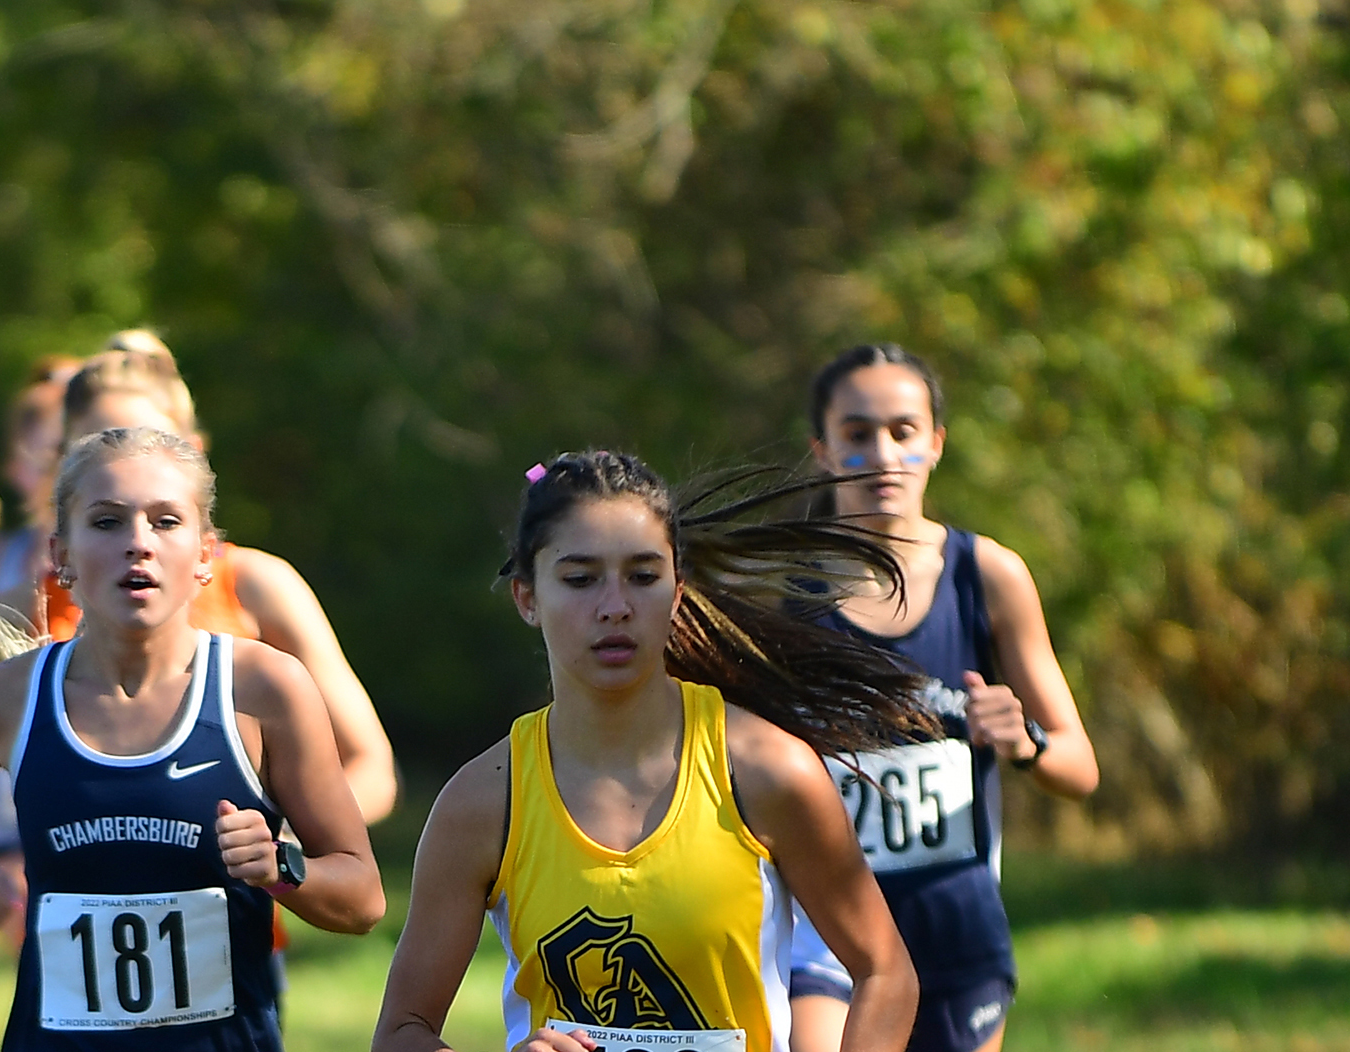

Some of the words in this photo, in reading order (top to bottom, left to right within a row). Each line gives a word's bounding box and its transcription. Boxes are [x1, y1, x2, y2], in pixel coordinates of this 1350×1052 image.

[840, 763, 948, 852] 265
[50, 816, 202, 851] CHAMBERSBURG
[102, 899, 123, 907] PIAA
[125, 898, 167, 907] DISTRICT
[71, 910, 191, 1013] 181
[59, 1018, 91, 1027] CROSS
[94, 1017, 136, 1027] COUNTRY
[140, 1010, 217, 1026] CHAMPIONSHIPS
[587, 1030, 607, 1040] 2022
[610, 1032, 633, 1043] PIAA
[636, 1034, 683, 1044] DISTRICT
[686, 1036, 694, 1044] III
